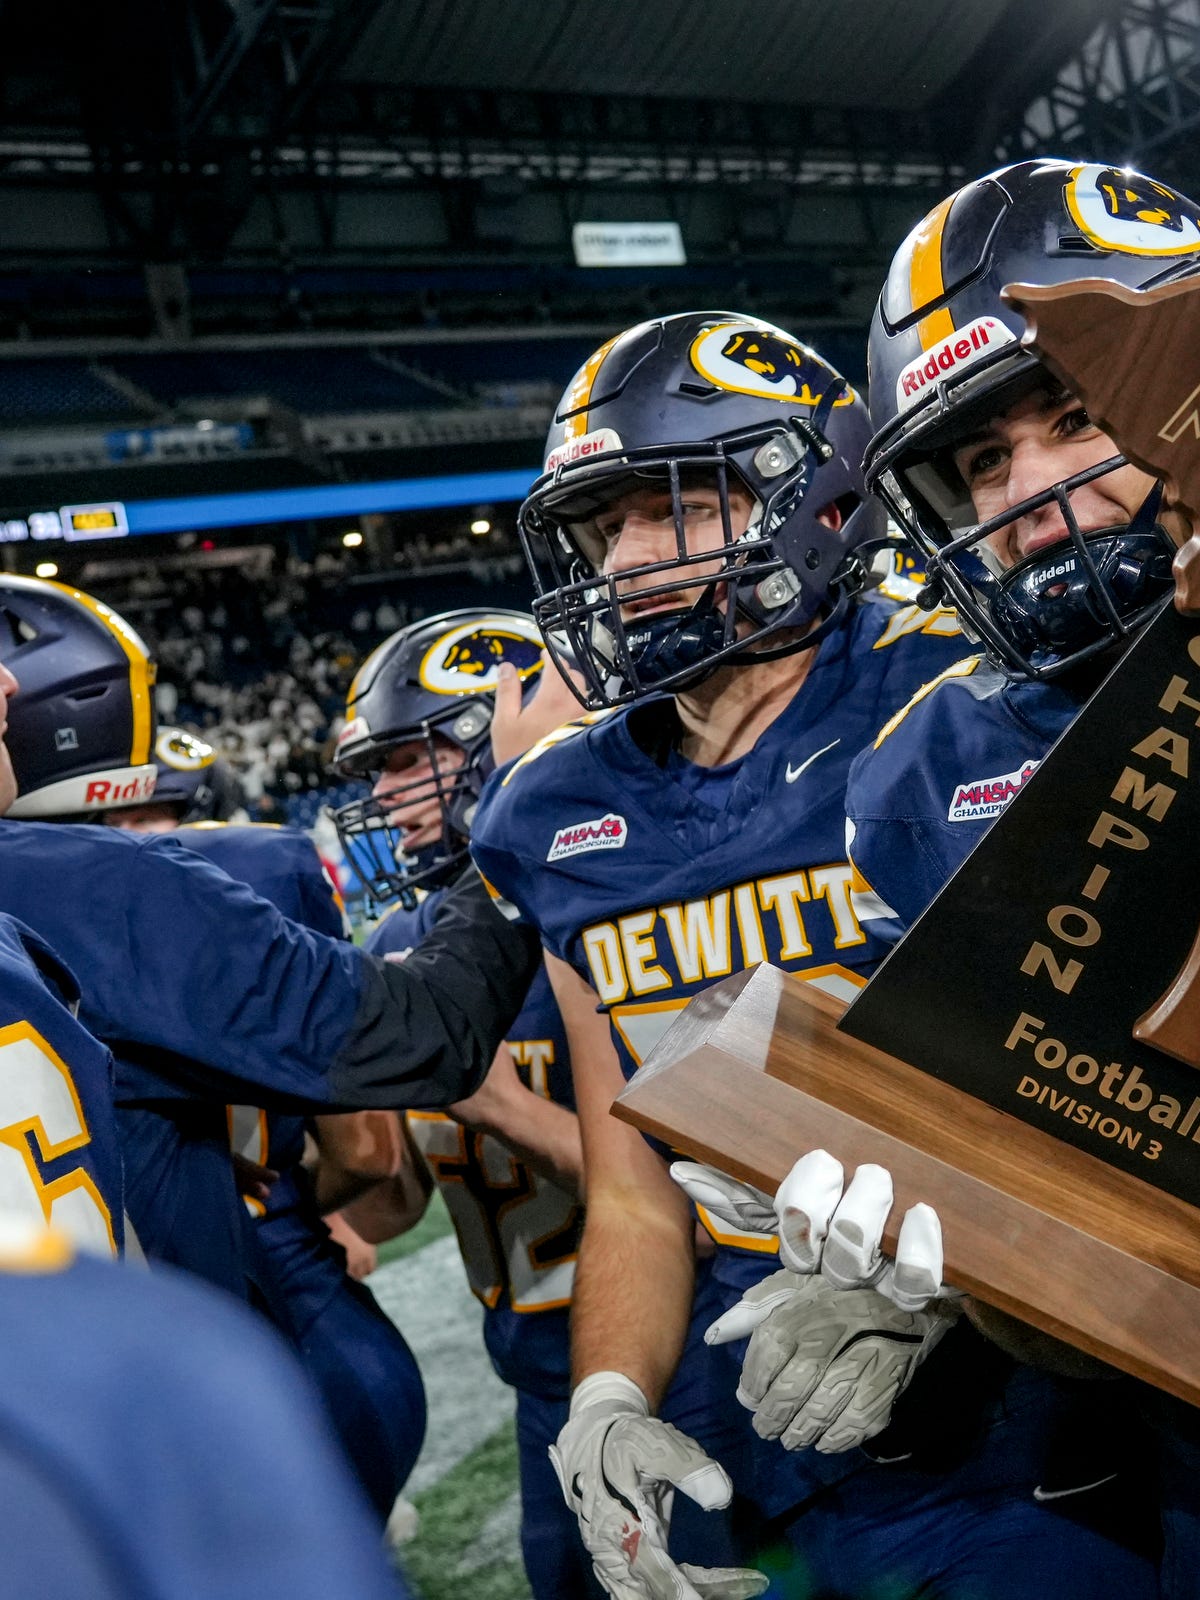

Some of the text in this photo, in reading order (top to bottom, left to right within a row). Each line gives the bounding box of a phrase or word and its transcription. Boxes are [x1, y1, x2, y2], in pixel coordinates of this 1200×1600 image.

[901, 321, 990, 397] Riddell
[582, 862, 868, 1005] DEWITT
[1016, 1075, 1164, 1161] DIVISION 3
